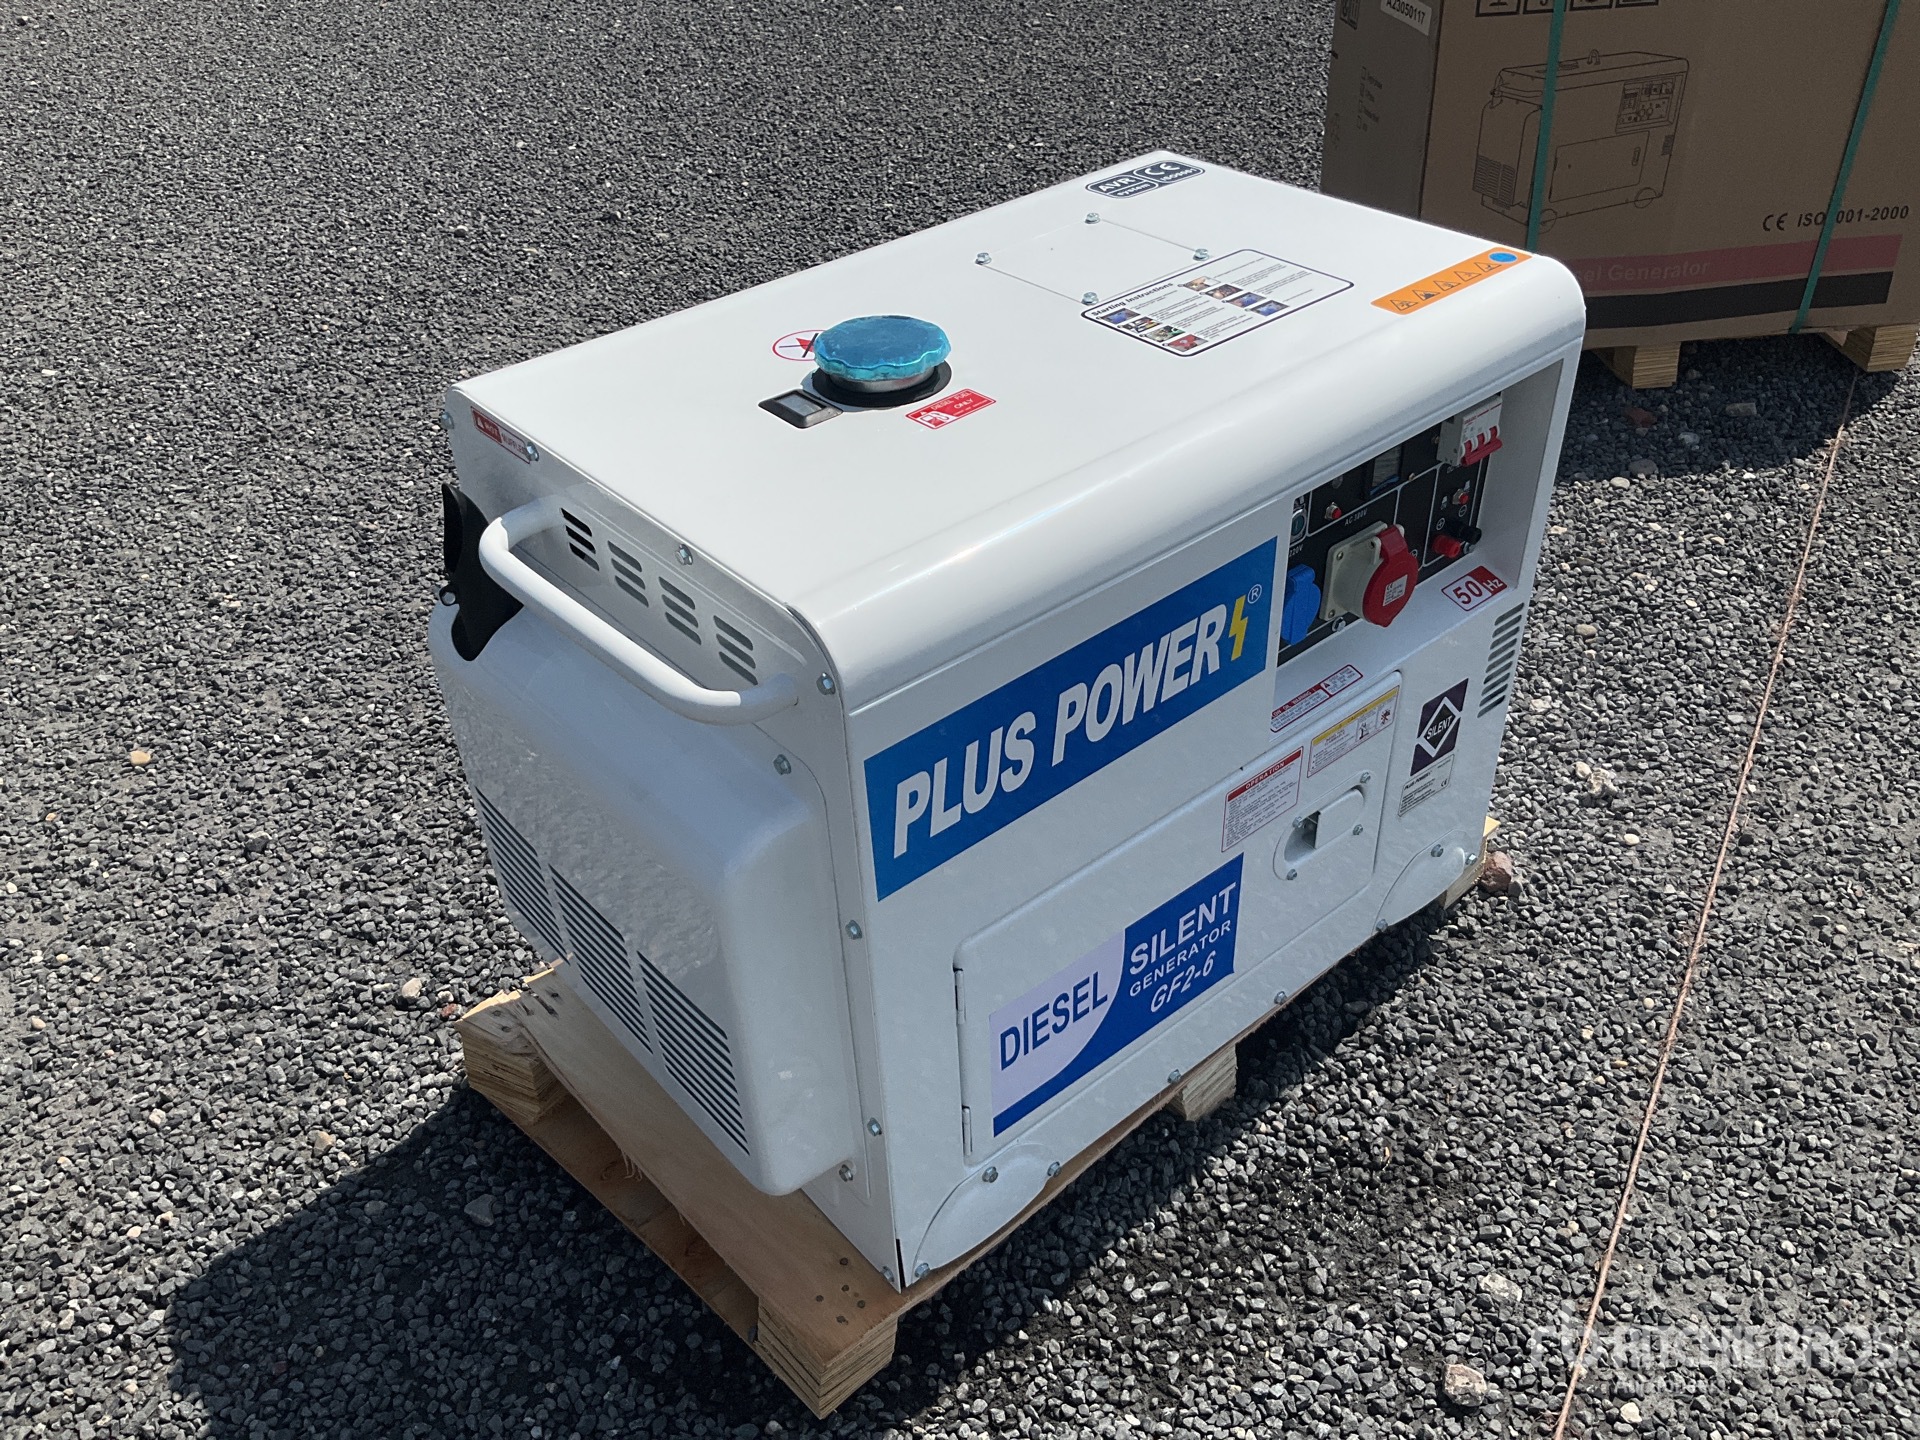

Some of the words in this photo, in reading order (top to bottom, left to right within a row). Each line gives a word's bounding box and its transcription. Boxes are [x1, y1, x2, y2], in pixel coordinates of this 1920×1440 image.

[1098, 177, 1136, 192] AVR
[1117, 183, 1151, 196] system
[1797, 205, 1910, 228] ISO001-2000
[1608, 260, 1711, 282] Generator
[1091, 301, 1127, 317] Starting
[953, 398, 974, 410] ONLY
[1452, 580, 1483, 605] 50
[1482, 578, 1504, 592] Hz
[893, 711, 1036, 859] PLUS
[1051, 603, 1228, 767] POWER
[1425, 714, 1454, 741] SILENT
[1245, 760, 1286, 790] OPERATION
[1129, 882, 1237, 976] SILENT
[1129, 919, 1232, 998] GENERATOR
[1150, 950, 1217, 1013] GF2-6
[1000, 971, 1108, 1071] DIESEL
